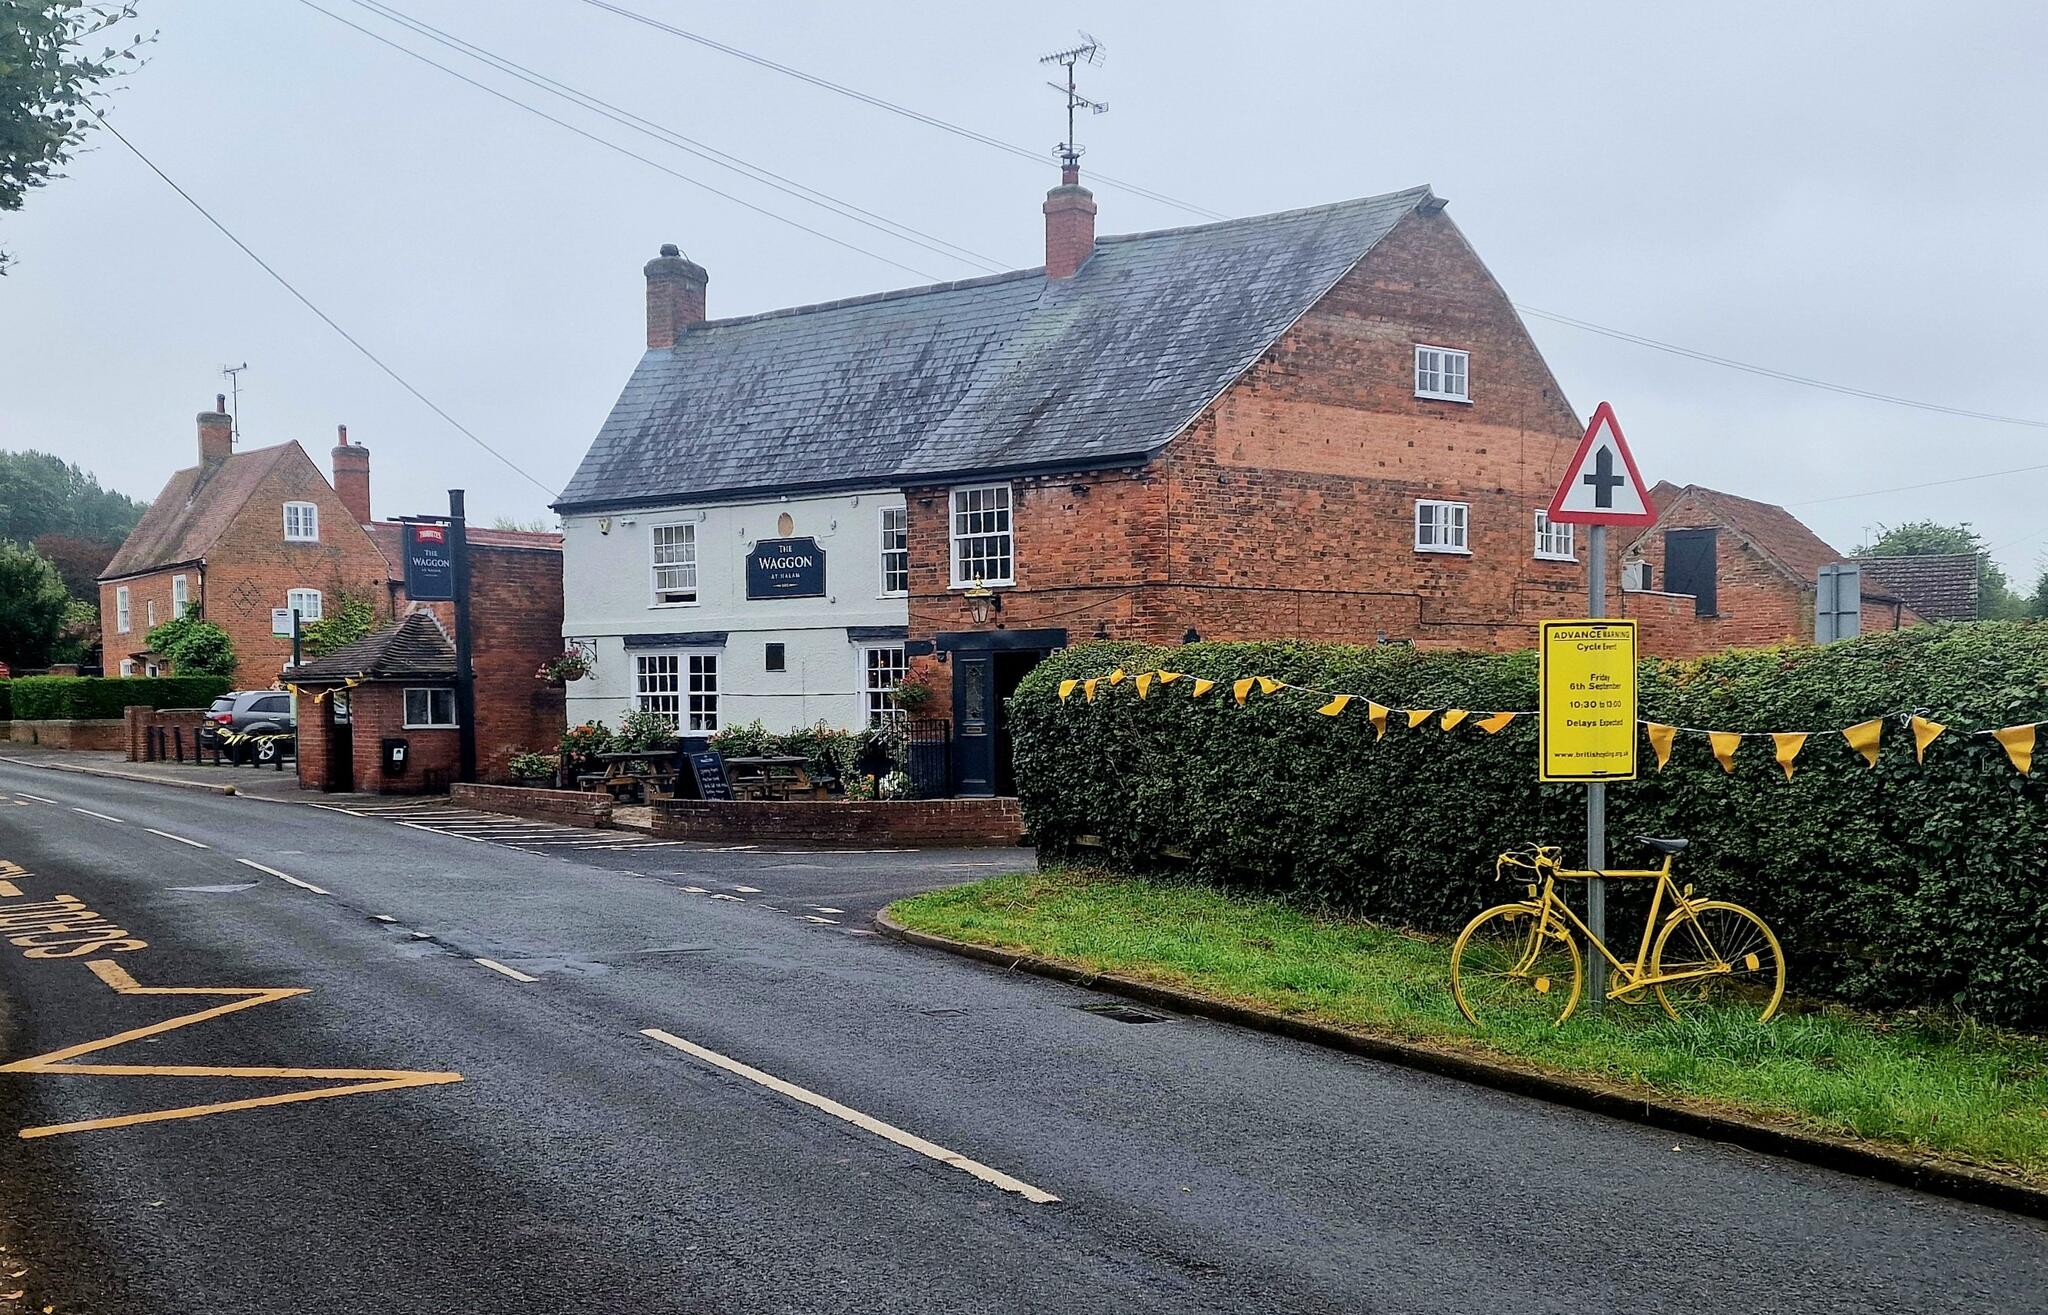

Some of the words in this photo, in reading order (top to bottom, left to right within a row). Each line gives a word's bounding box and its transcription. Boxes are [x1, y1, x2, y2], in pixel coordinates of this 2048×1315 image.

[424, 549, 438, 557] THE
[778, 545, 792, 553] THE
[412, 557, 450, 568] WAGGON
[758, 555, 813, 570] WAGGON
[1554, 630, 1602, 639] ADVANCE
[1576, 643, 1601, 652] Cycle
[1569, 682, 1586, 690] 6th
[1569, 700, 1597, 709] 10:30
[1566, 719, 1597, 728] Delays
